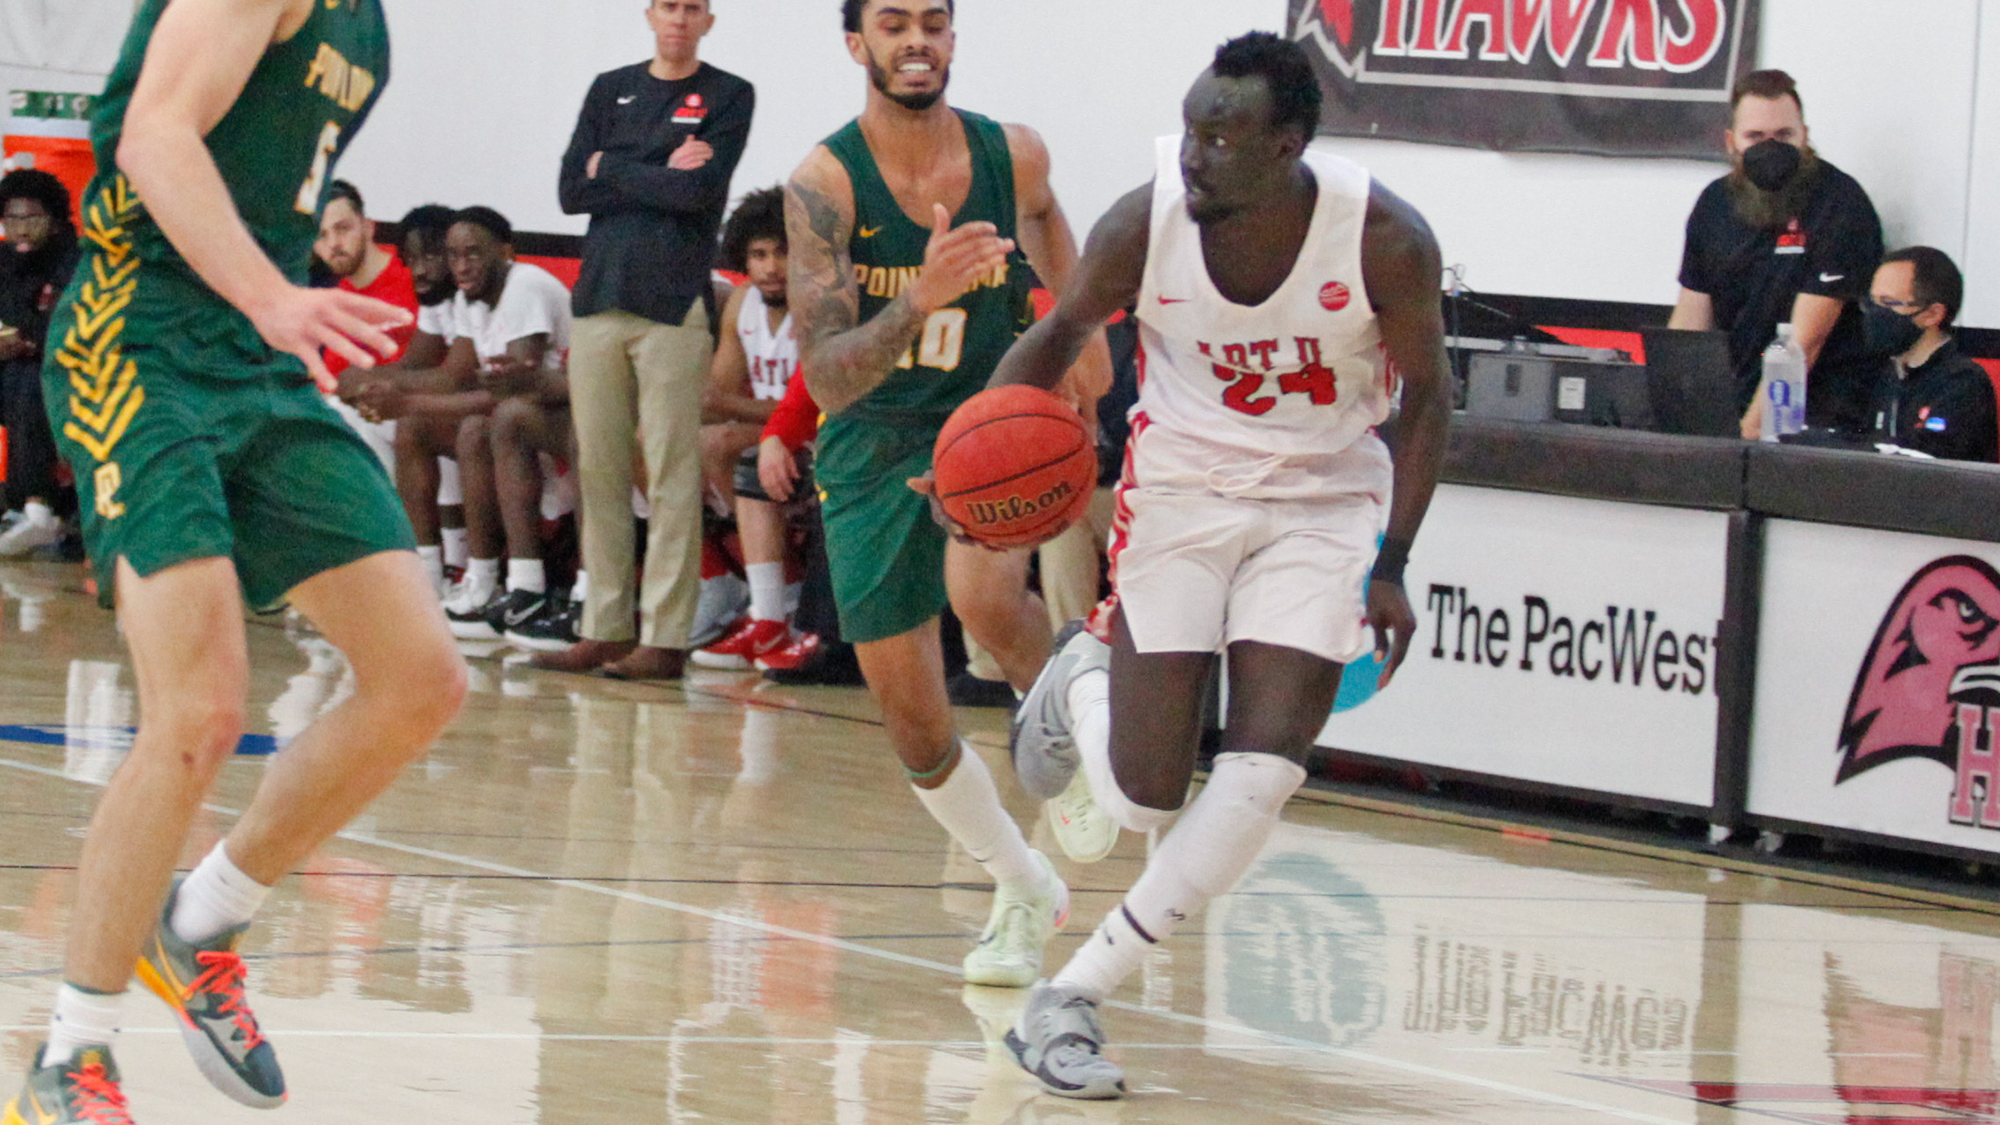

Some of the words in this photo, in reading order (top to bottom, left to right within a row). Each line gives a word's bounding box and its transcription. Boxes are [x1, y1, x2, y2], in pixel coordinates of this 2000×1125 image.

[853, 264, 924, 298] POIN
[1212, 362, 1337, 416] 24
[966, 481, 1072, 524] Wilson
[1427, 583, 1510, 668] The
